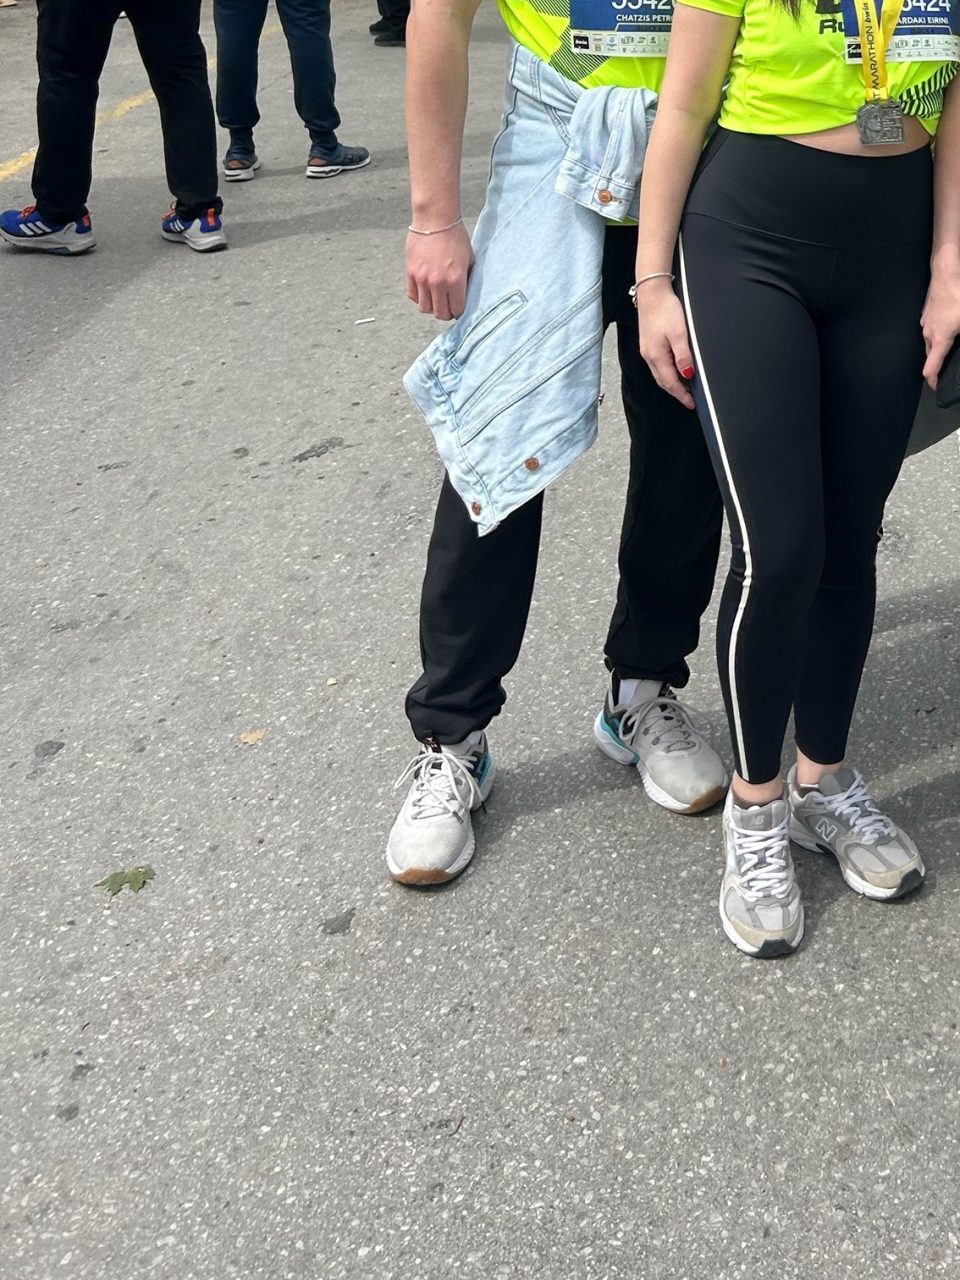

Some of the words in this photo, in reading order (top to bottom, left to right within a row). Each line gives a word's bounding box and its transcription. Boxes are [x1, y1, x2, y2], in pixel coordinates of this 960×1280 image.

[616, 14, 650, 22] CHATZIS
[928, 17, 949, 25] EIRINI
[866, 26, 881, 90] MARATHON
